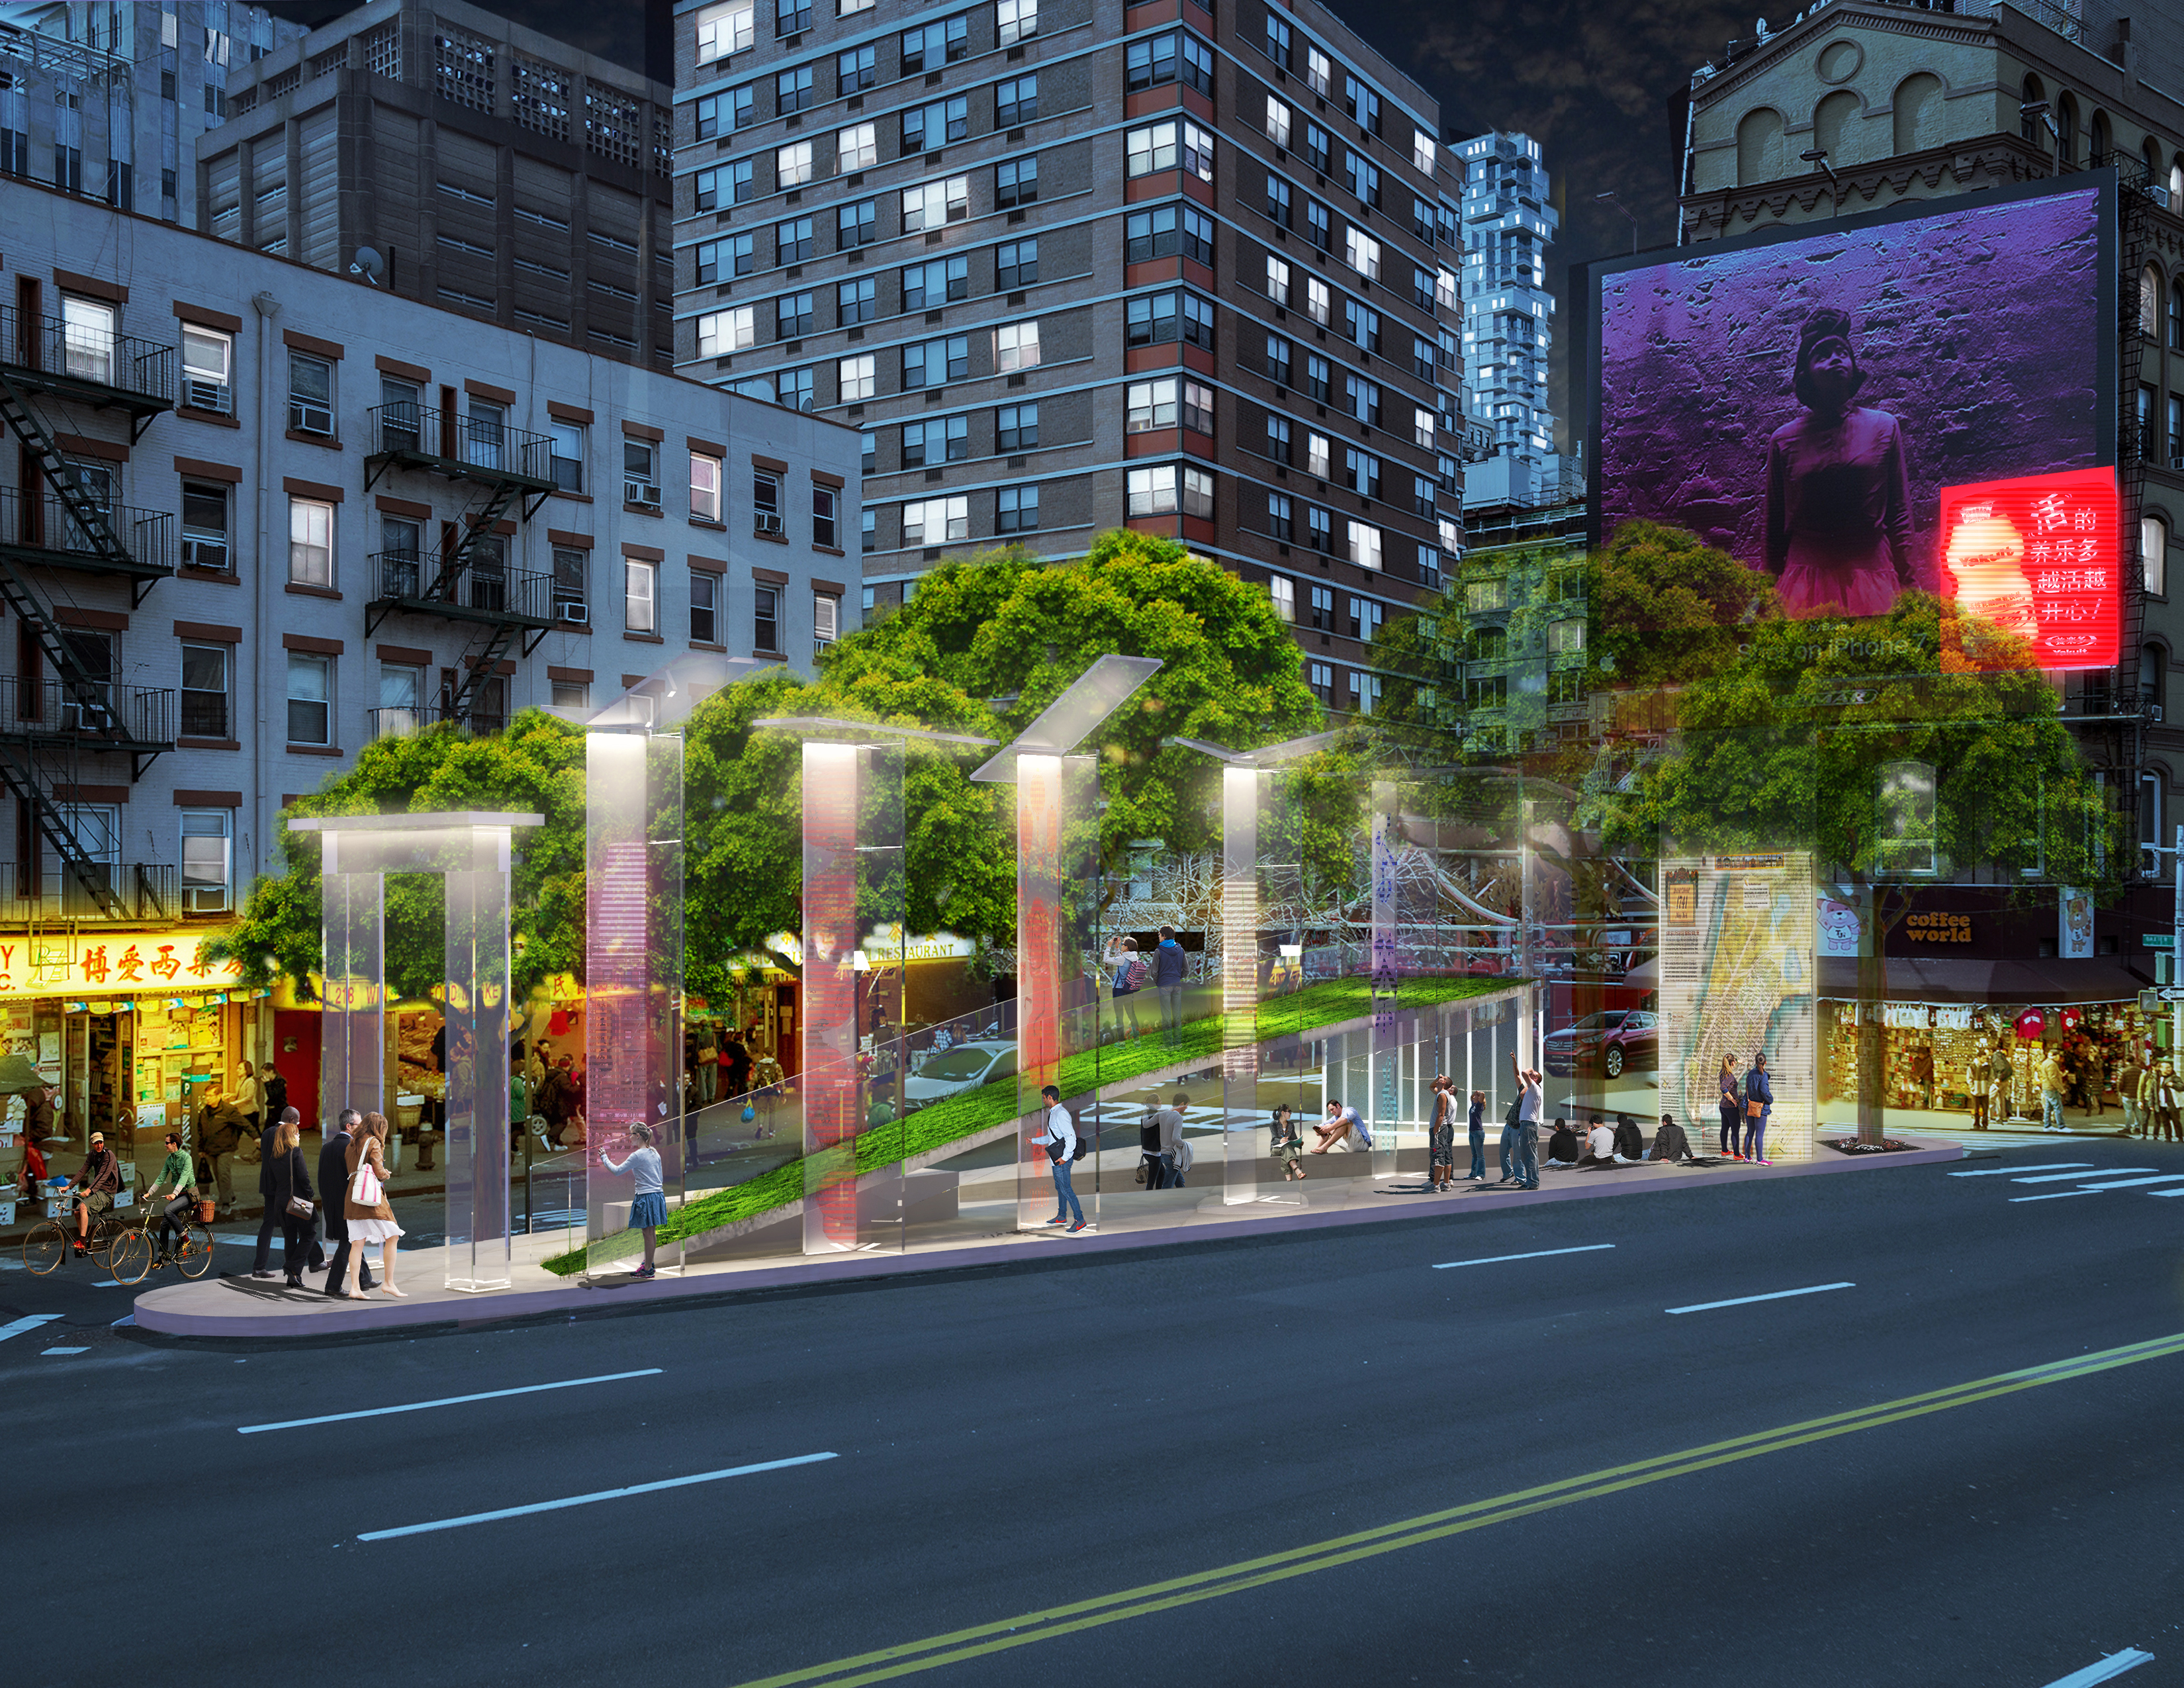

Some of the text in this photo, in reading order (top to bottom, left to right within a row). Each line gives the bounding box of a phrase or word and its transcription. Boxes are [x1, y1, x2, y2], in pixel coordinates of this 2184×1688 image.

[2029, 493, 2097, 536] 活的
[1959, 546, 2015, 567] Yakult
[2030, 538, 2098, 564] 养乐多
[2037, 567, 2107, 594] 越活越
[1829, 637, 1909, 657] iPhone
[1913, 633, 1927, 653] 7
[2052, 648, 2089, 657] Yakult
[1906, 912, 1972, 927] coffee
[1906, 927, 1972, 943] world
[335, 986, 355, 1004] 218
[184, 1082, 191, 1094] P
